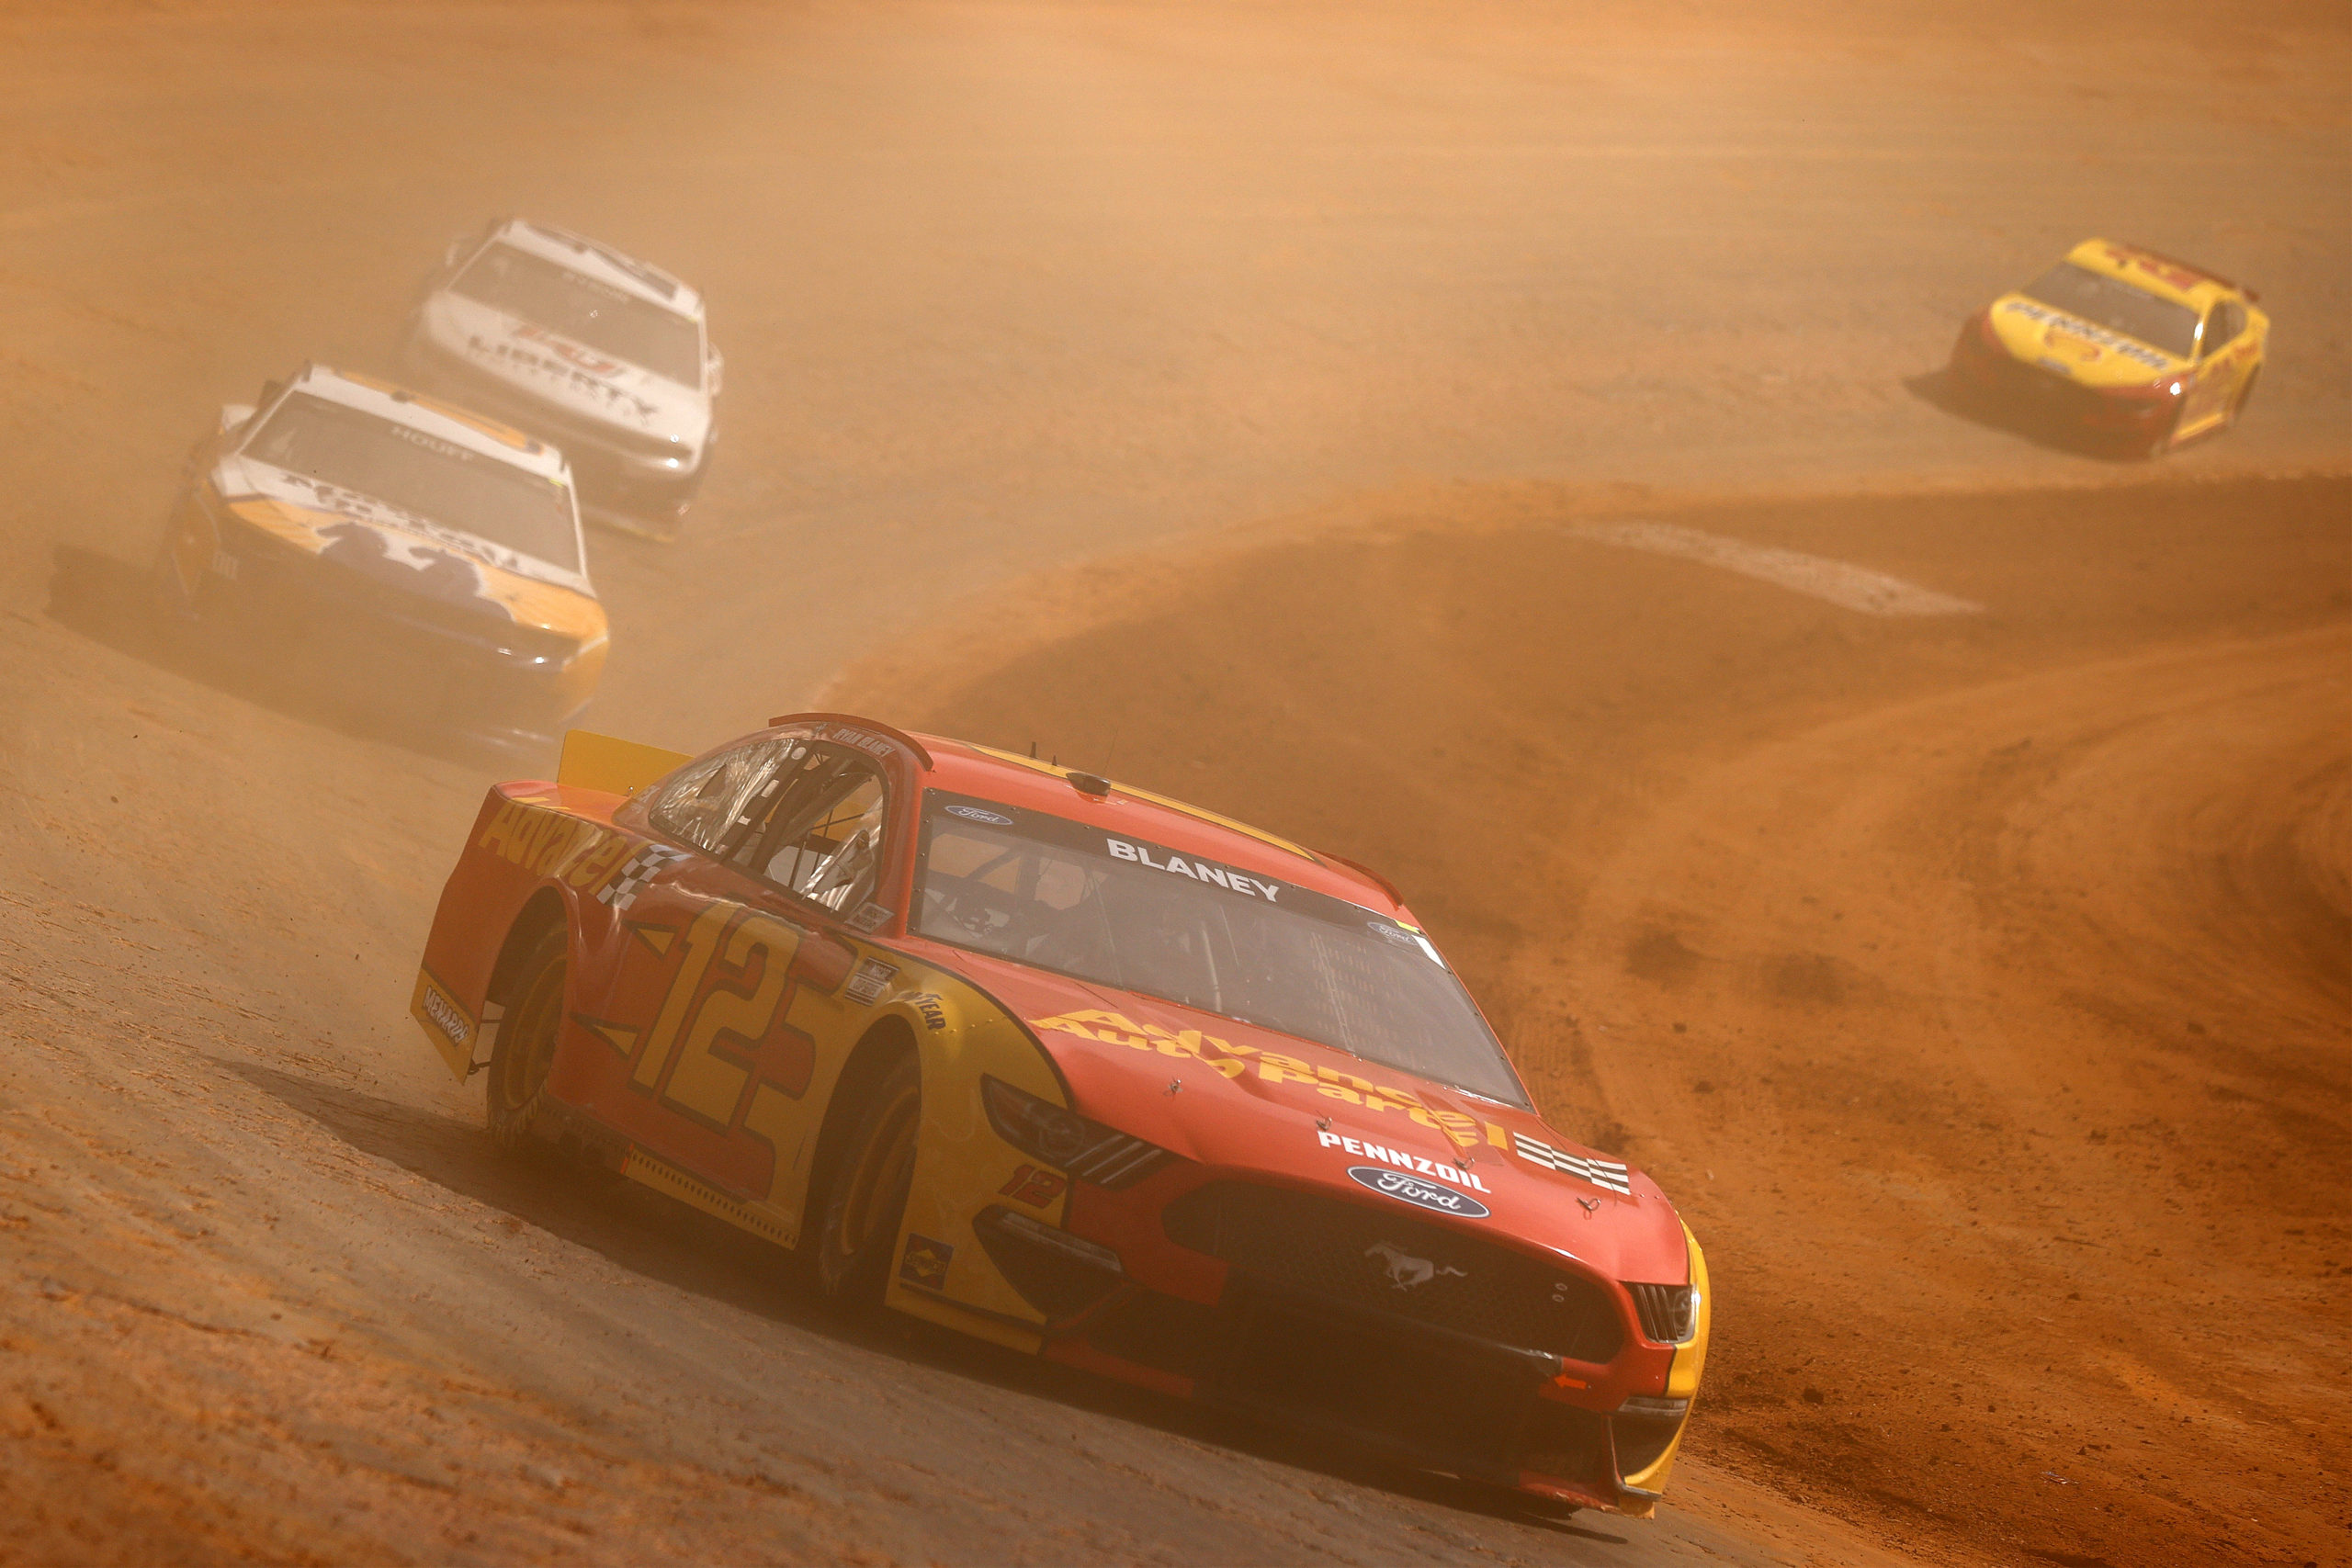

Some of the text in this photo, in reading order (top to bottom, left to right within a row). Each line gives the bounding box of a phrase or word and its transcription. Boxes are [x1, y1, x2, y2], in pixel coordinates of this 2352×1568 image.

[1106, 838, 1279, 903] BLANEY
[423, 984, 469, 1043] MENARDS
[632, 902, 799, 1127] 12
[1027, 1016, 1479, 1147] Auto Parts
[1058, 1010, 1476, 1127] Advance
[998, 1164, 1067, 1209] 12
[1317, 1130, 1491, 1193] PENNZOIL
